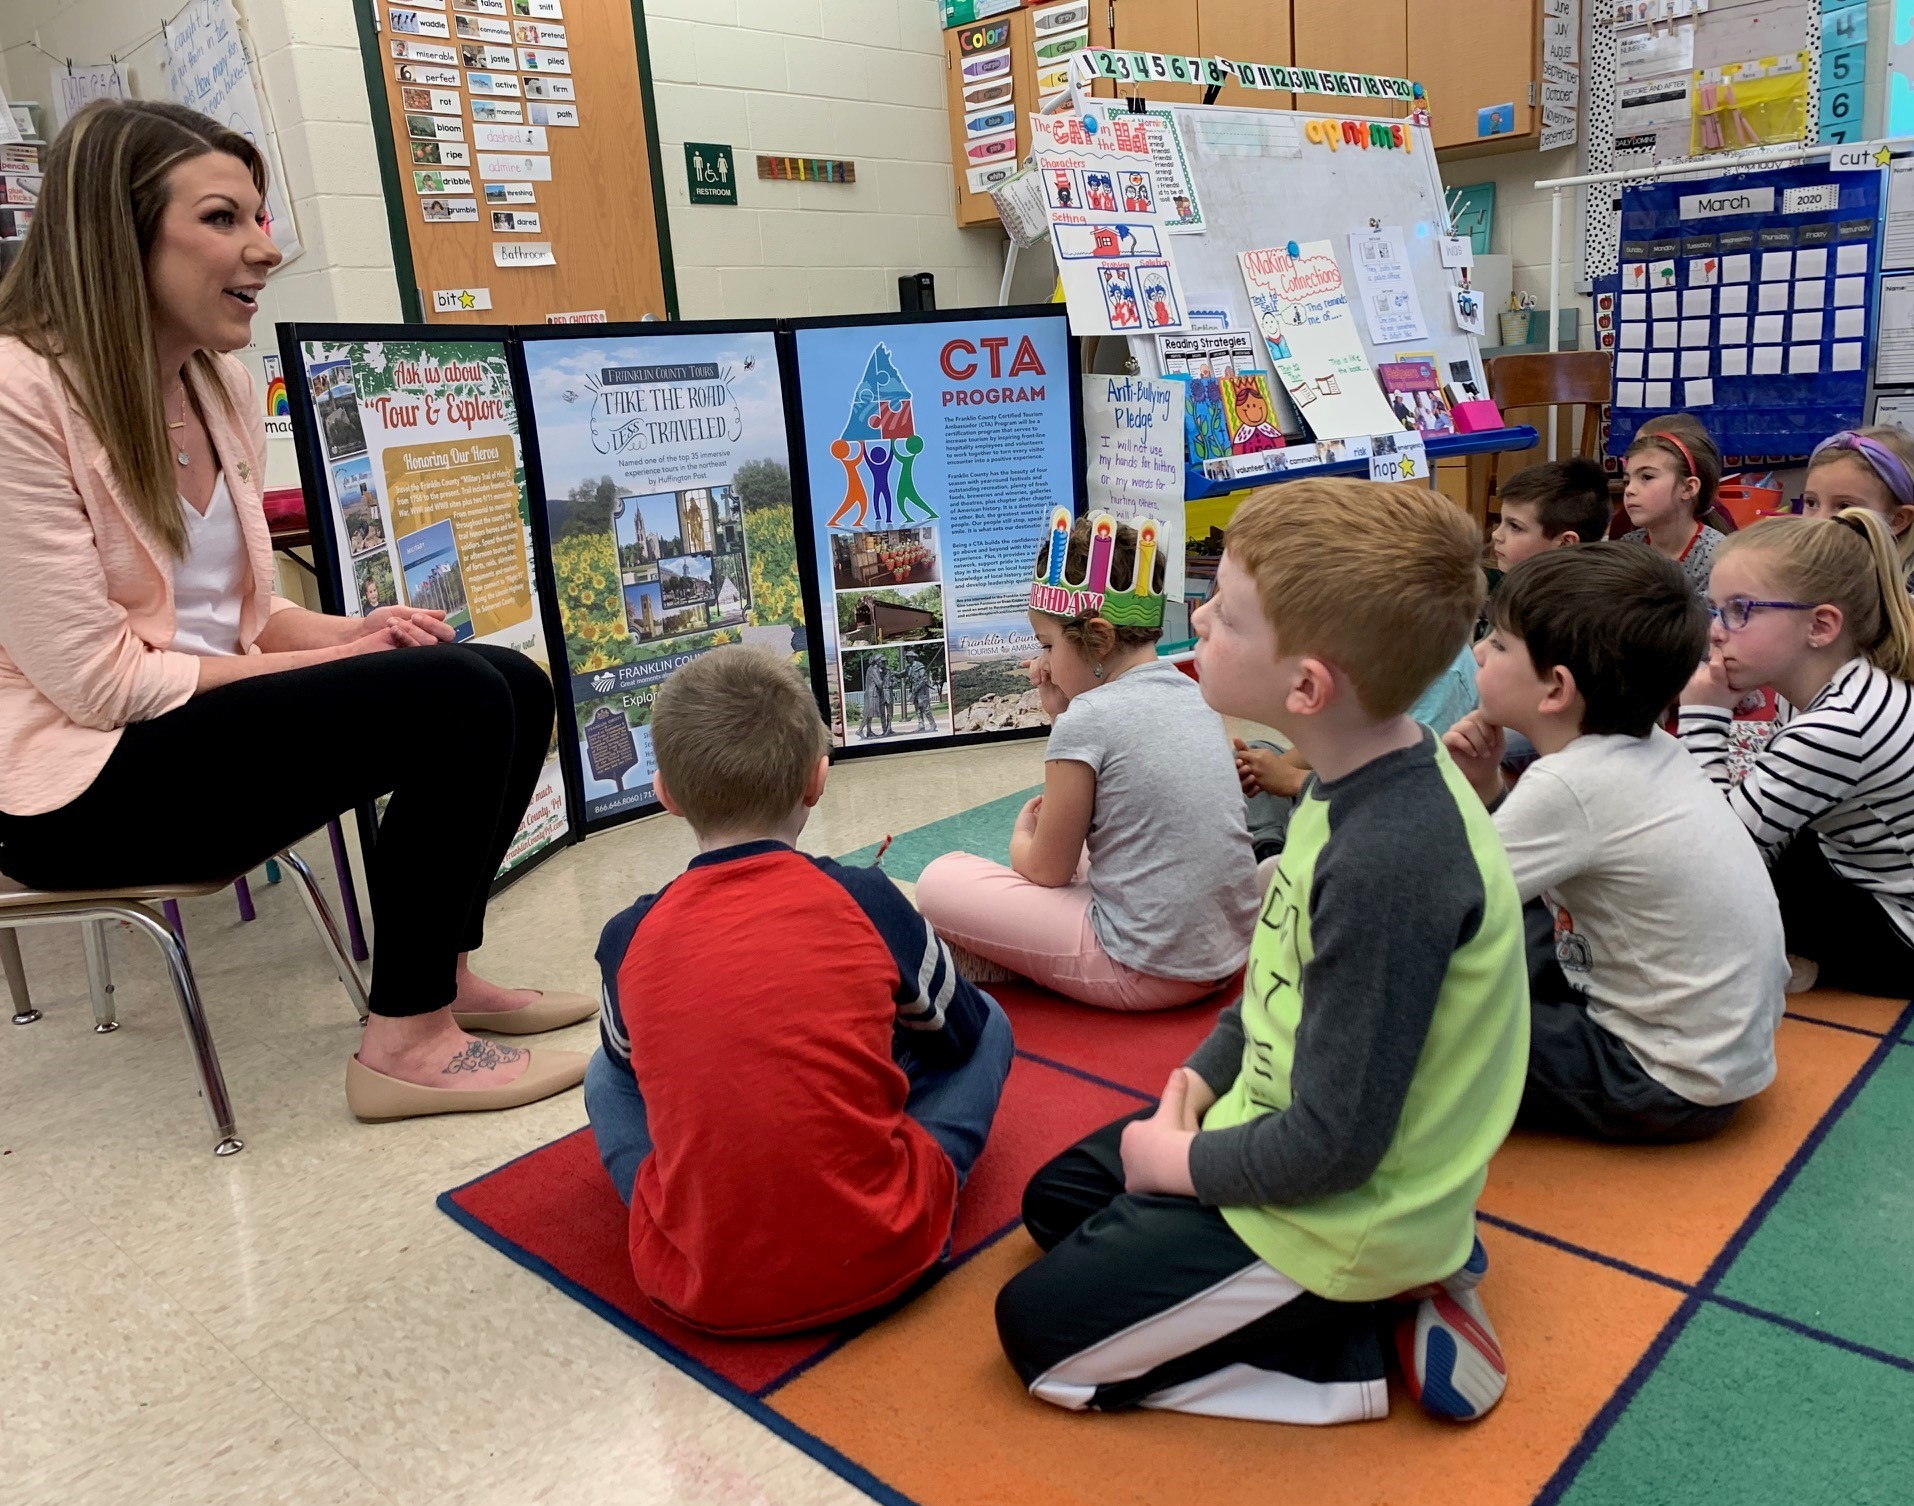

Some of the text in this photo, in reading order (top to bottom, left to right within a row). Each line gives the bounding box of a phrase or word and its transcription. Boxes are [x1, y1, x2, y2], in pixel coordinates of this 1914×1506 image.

[1554, 2, 1570, 15] June
[419, 20, 446, 30] waddle
[1058, 12, 1074, 22] gray
[480, 26, 510, 35] commotion
[540, 30, 565, 40] pretend
[1836, 16, 1856, 39] 4
[960, 25, 1008, 50] Colors
[416, 50, 454, 61] miserable
[491, 54, 510, 64] jostle
[1550, 46, 1572, 60] August
[548, 58, 564, 66] piled
[1083, 54, 1096, 74] 1
[1101, 53, 1116, 74] 2
[1117, 57, 1130, 78] 3
[1134, 57, 1149, 78] 4
[1152, 56, 1165, 77] 5
[1172, 58, 1185, 78] 6
[1221, 59, 1235, 73] 9
[1833, 53, 1850, 79] 5
[426, 74, 456, 84] perfect
[1189, 61, 1199, 81] 7
[1208, 62, 1219, 81] 8
[1237, 65, 1255, 84] 10
[1258, 67, 1271, 86] 11
[1271, 68, 1290, 87] 12
[1288, 70, 1302, 87] 13
[1544, 61, 1578, 83] September
[495, 81, 517, 89] active
[1302, 70, 1319, 90] 14
[1319, 73, 1335, 91] 15
[1336, 75, 1350, 93] 16
[1349, 76, 1362, 94] 17
[1364, 78, 1380, 95] 18
[1378, 78, 1394, 95] 19
[1623, 80, 1685, 96] BEFORE AND AFTER
[1393, 81, 1409, 96] 20
[1546, 88, 1573, 100] October
[440, 98, 451, 106] rot
[1832, 93, 1849, 118] 6
[496, 108, 521, 116] mammal
[557, 111, 572, 120] path
[1545, 107, 1575, 126] November
[437, 124, 461, 132] bloom
[988, 117, 1000, 125] blue
[487, 131, 521, 144] dashed
[1031, 117, 1092, 145] The CAT
[1098, 121, 1149, 154] the Hat
[1101, 125, 1111, 136] in
[1541, 128, 1575, 147] December
[990, 143, 1002, 152] pink
[1615, 137, 1632, 147] DAILY
[446, 150, 462, 159] ripe
[1041, 157, 1085, 168] Characters
[1840, 150, 1870, 166] cut
[1, 163, 29, 172] pencils
[489, 162, 521, 173] admire
[442, 177, 470, 186] dribble
[696, 188, 731, 196] RESTROOM
[1797, 193, 1822, 206] 2020
[449, 206, 476, 216] grumble
[1698, 194, 1750, 214] March
[517, 218, 536, 226] dared
[1052, 213, 1086, 223] Setting
[1762, 233, 1791, 241] Thursday
[1805, 231, 1827, 239] Friday
[502, 247, 549, 260] Bathroom
[1101, 261, 1130, 269] Problem
[1140, 259, 1170, 267] Solution
[1250, 252, 1297, 278] Making
[1281, 266, 1340, 293] Connections
[438, 292, 457, 306] bit
[1305, 295, 1347, 311] This reminds
[1165, 336, 1246, 350] Reading Strategies
[940, 335, 1046, 381] CTA
[393, 361, 482, 388] Ask us about
[608, 364, 714, 383] FRANKLIN COUNTY TOURS
[601, 384, 726, 415] TAKE THE ROAD
[942, 385, 1046, 407] PROGRAM
[1108, 378, 1171, 421] Anti-Bullying
[425, 394, 441, 425] &
[609, 416, 726, 451] LESS TRAVELED
[1115, 408, 1153, 444] Pledge
[1117, 438, 1163, 456] will not use
[1354, 447, 1367, 457] risk
[1397, 442, 1424, 450] emergency
[403, 445, 499, 470] Honoring Our Heroes
[618, 458, 643, 467] Named
[659, 455, 665, 463] of
[667, 453, 678, 462] the
[679, 454, 690, 464] top
[701, 450, 730, 459] immersive
[1289, 454, 1320, 466] community
[625, 460, 727, 478] experience tours the northeast
[1100, 454, 1176, 484] my hands hitting
[1235, 463, 1265, 475] volunteer
[1373, 459, 1397, 479] hop
[442, 478, 460, 488] County
[648, 471, 708, 486] by Huffington Post.
[1101, 475, 1153, 490] or my words
[961, 631, 1038, 648] Franklin Coun
[968, 646, 998, 656] TOURISM
[619, 660, 673, 680] FRANKLIN
[620, 675, 661, 688] Great moments
[535, 784, 553, 801] much
[594, 795, 639, 814] 866.646.8060
[527, 805, 550, 825] County,
